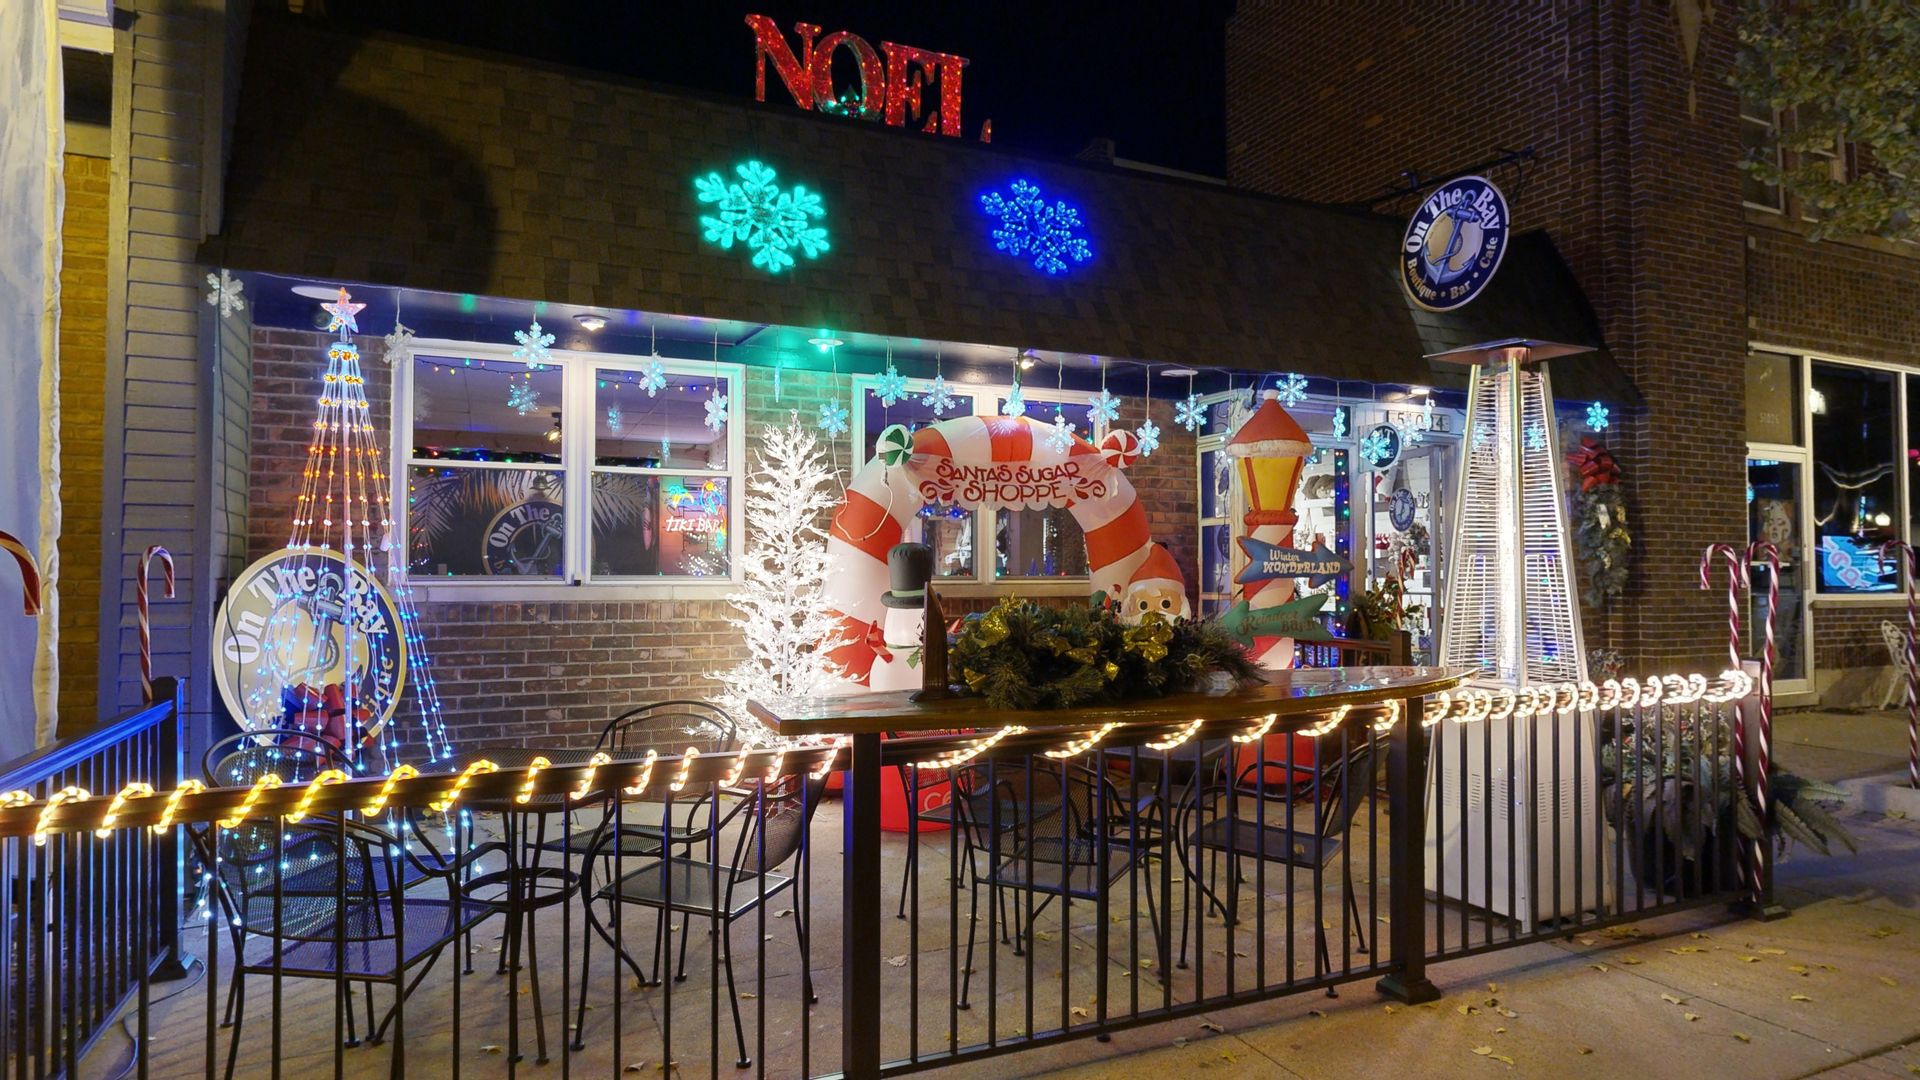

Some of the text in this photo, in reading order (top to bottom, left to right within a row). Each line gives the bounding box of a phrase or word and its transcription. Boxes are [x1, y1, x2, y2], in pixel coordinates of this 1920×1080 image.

[744, 13, 992, 144] NOEL
[1405, 186, 1501, 254] On The Bay
[1407, 236, 1499, 300] Boutique Bar Cafe
[936, 458, 1083, 484] SANTA'S SUGAR
[963, 479, 1067, 503] SHOPPE
[489, 504, 550, 548] On The
[1263, 561, 1341, 574] WONDERLAND
[1269, 549, 1300, 562] Winter
[224, 609, 268, 664] On
[247, 564, 317, 610] The
